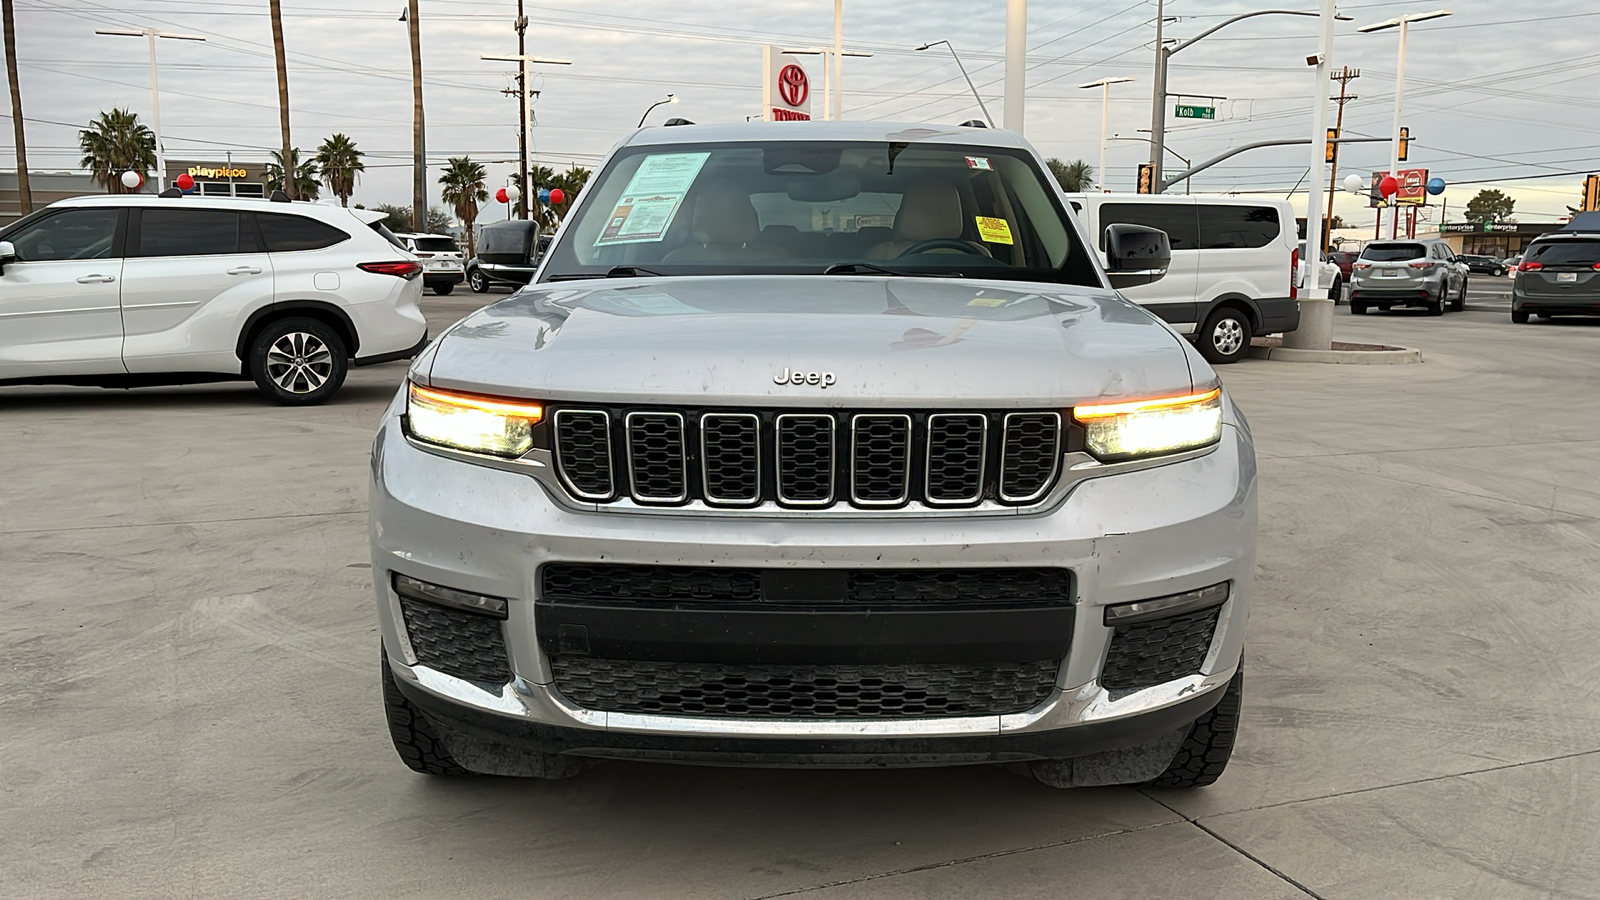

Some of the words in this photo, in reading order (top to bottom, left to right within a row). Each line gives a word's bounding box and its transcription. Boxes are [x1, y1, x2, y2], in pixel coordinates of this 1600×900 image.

[1179, 107, 1194, 117] Kolb
[187, 165, 247, 179] playplace
[773, 367, 837, 389] Jeep
